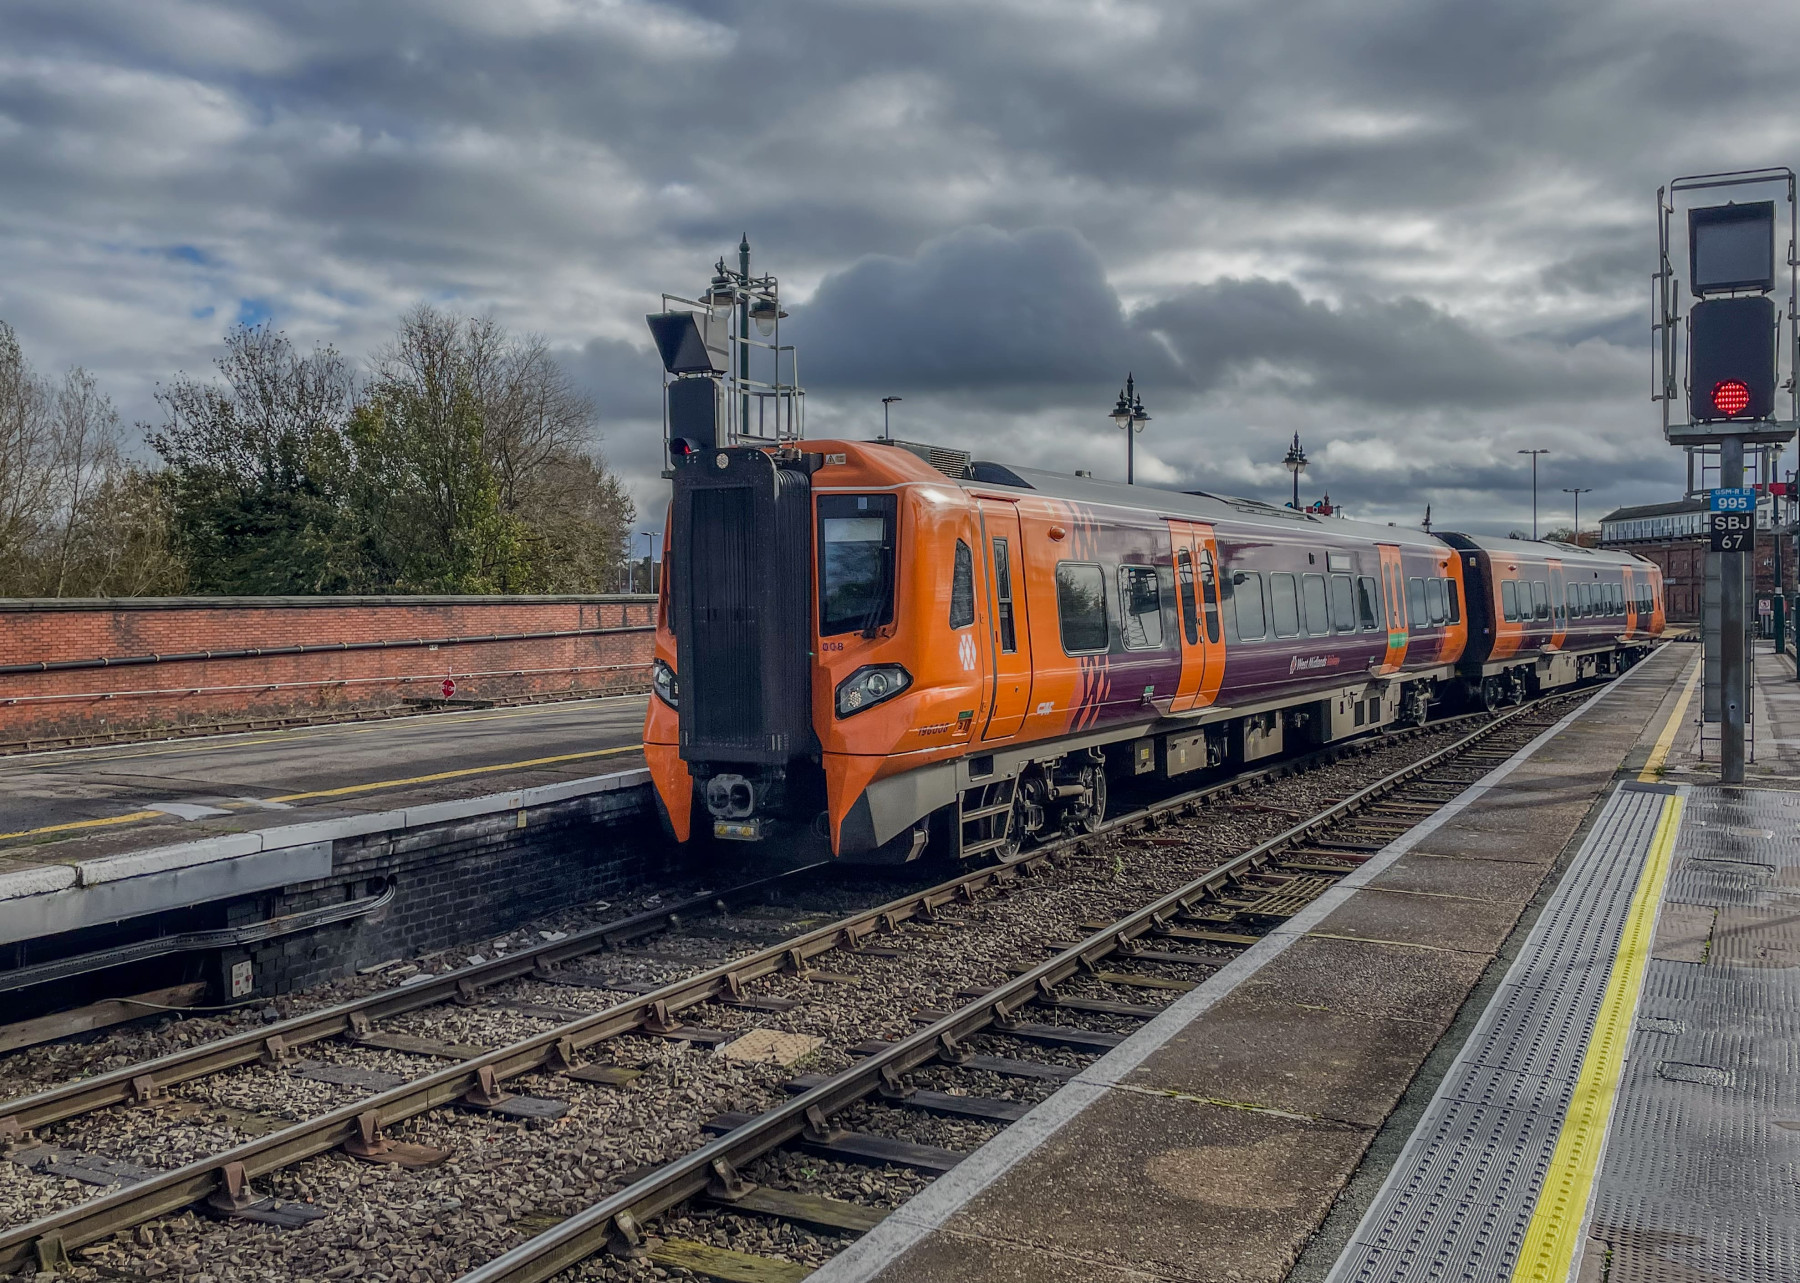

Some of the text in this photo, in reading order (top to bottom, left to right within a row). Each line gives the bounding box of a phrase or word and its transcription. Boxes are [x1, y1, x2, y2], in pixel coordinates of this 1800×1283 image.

[1718, 497, 1747, 509] 995
[1714, 516, 1750, 530] SBJ
[1721, 534, 1743, 549] 67
[822, 642, 844, 651] 008
